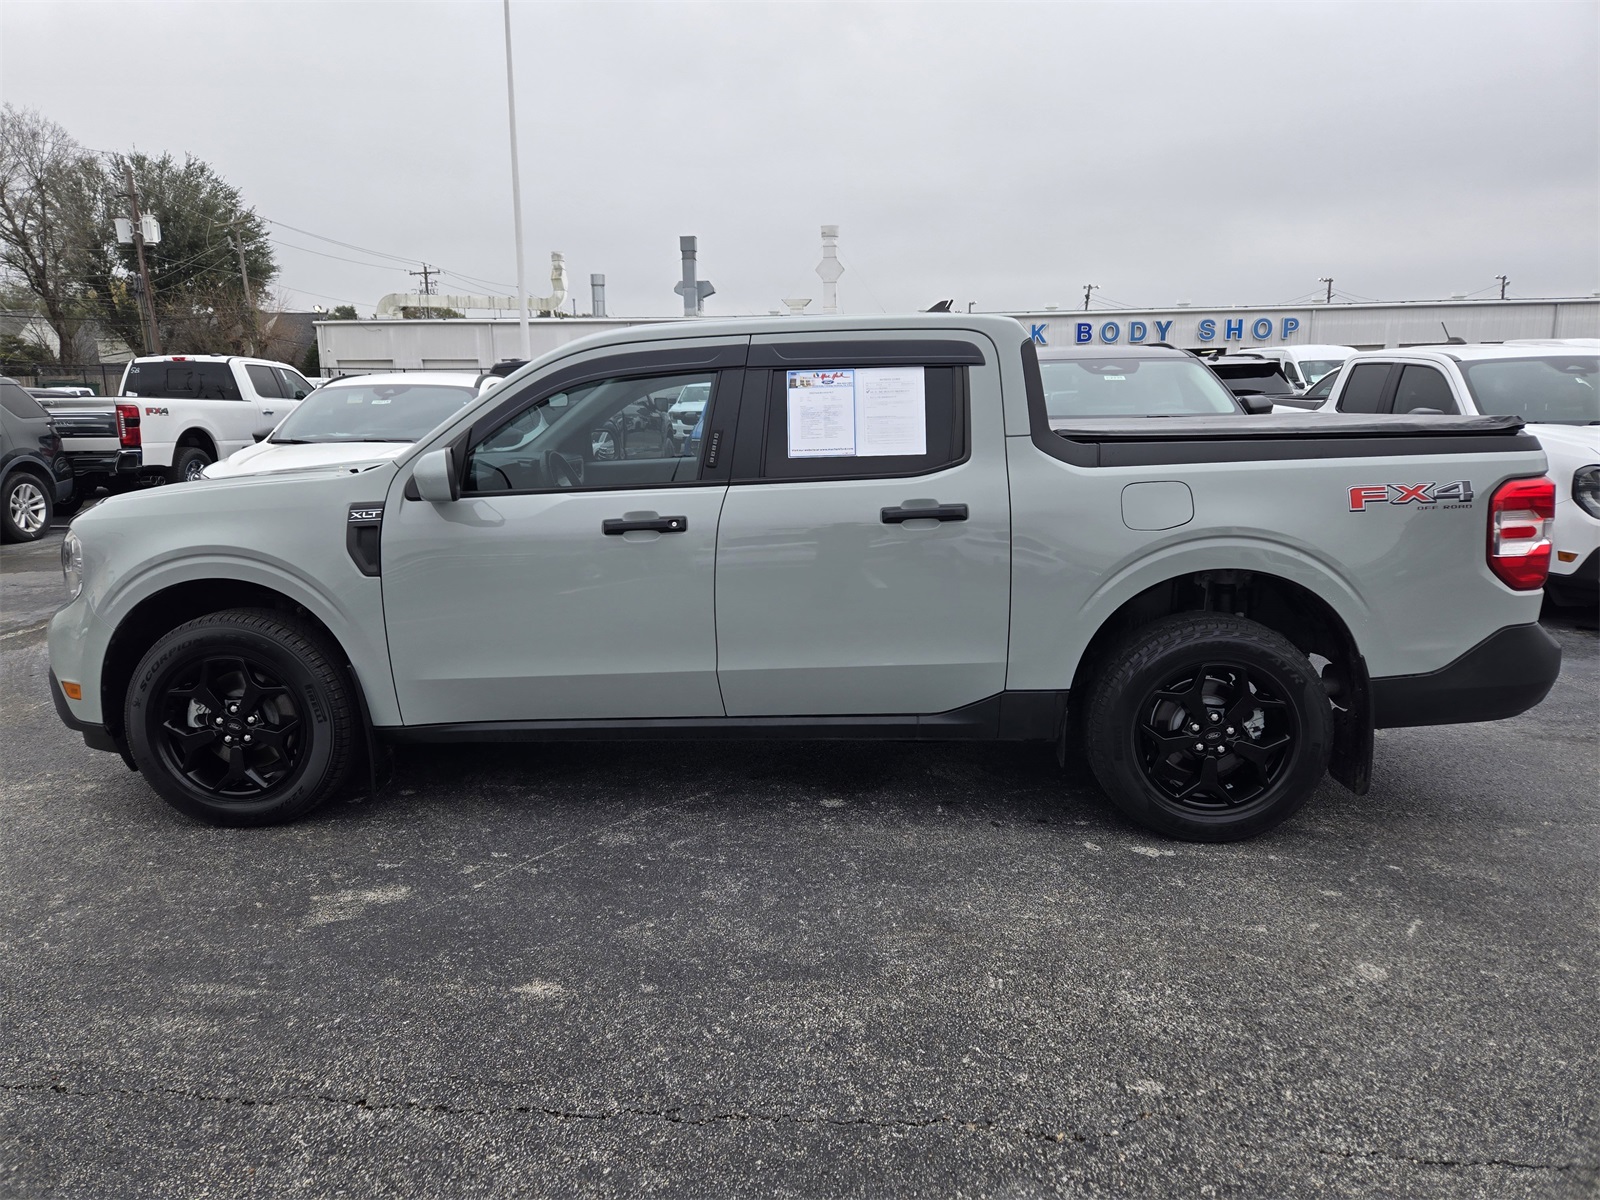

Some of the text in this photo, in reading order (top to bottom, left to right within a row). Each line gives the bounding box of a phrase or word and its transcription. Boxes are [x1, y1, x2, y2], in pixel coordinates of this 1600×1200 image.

[1075, 319, 1173, 344] BODY
[1198, 316, 1300, 342] SHOP
[145, 407, 169, 415] FX4
[1347, 480, 1474, 512] FX4
[350, 510, 381, 519] XLT
[139, 635, 204, 693] SCORPION
[304, 683, 328, 724] PIRELLI
